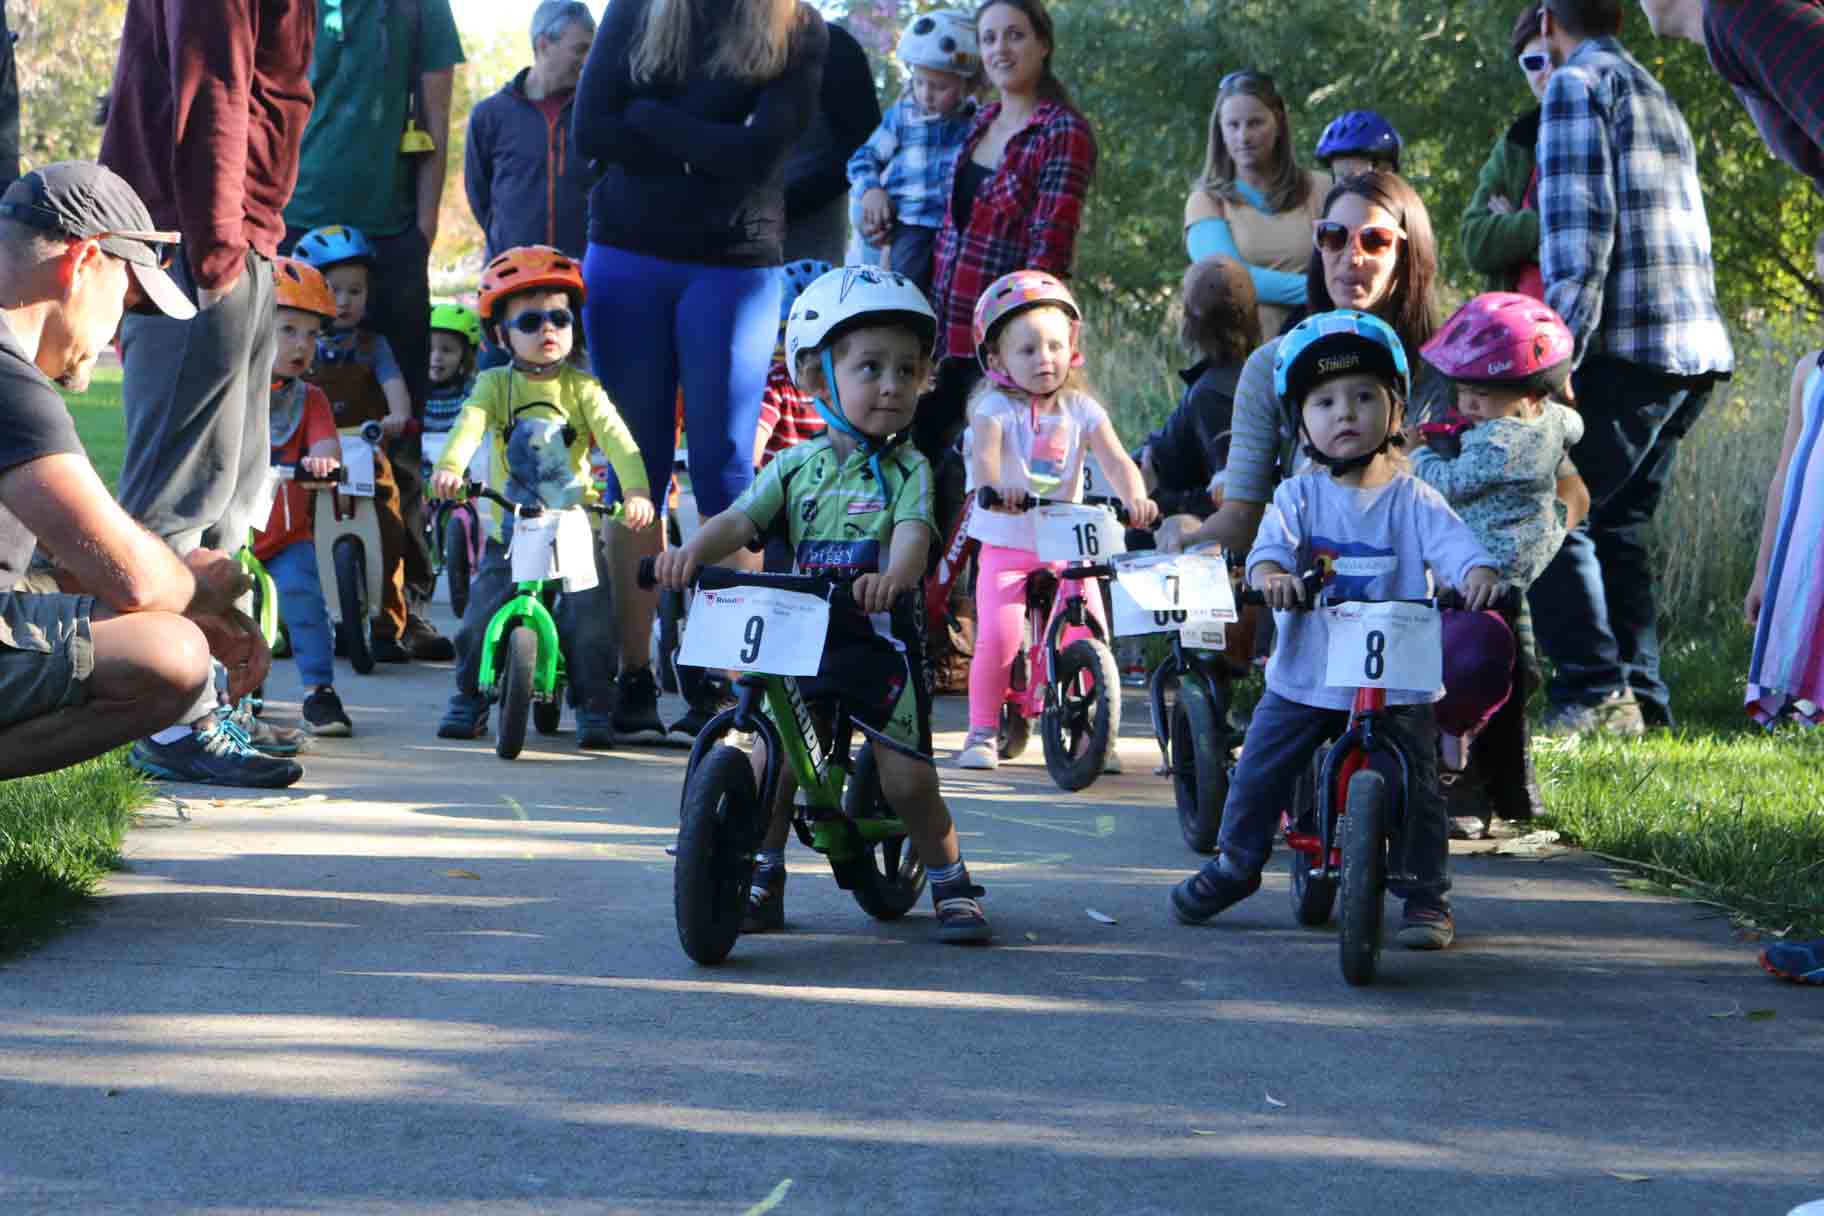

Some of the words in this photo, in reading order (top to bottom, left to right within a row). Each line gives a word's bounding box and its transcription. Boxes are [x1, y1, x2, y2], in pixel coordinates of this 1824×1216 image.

[1072, 523, 1099, 556] 16
[1166, 575, 1179, 605] 7
[740, 616, 765, 664] 9
[1364, 630, 1385, 680] 8
